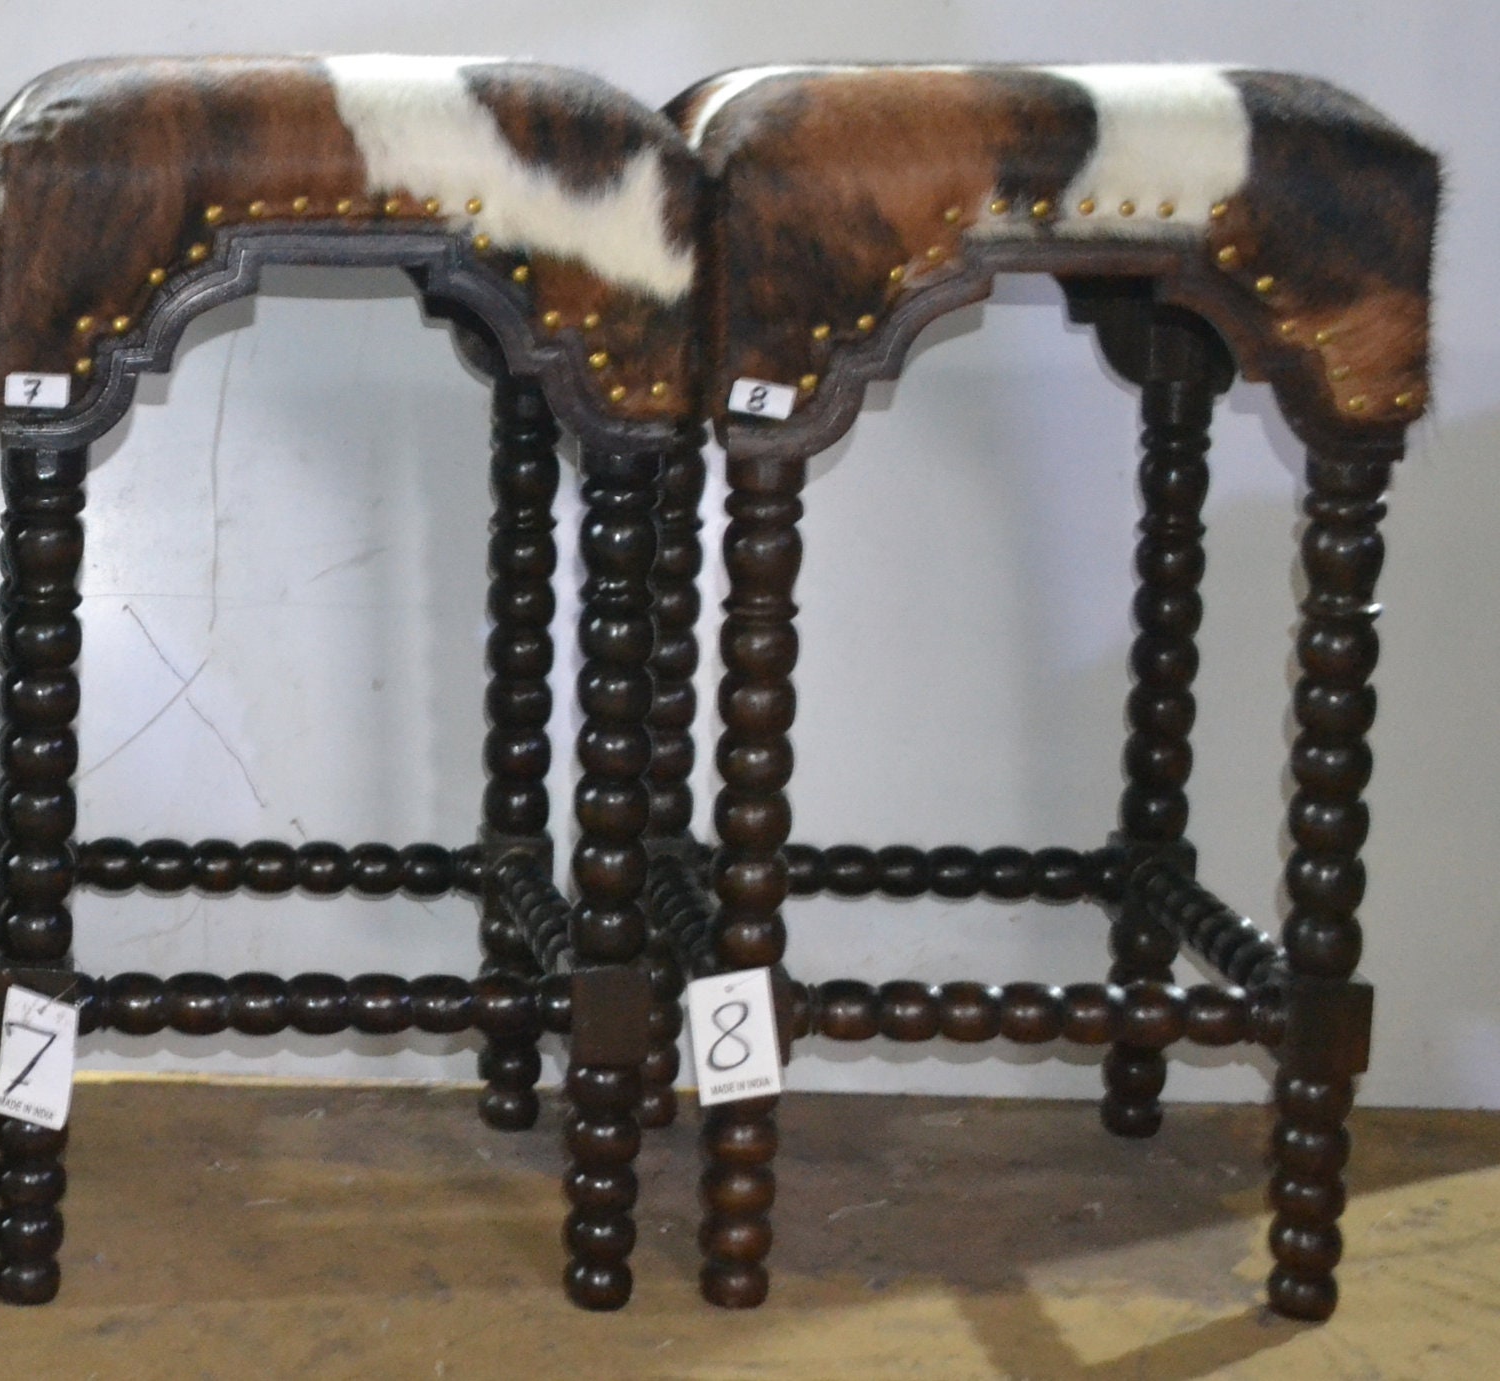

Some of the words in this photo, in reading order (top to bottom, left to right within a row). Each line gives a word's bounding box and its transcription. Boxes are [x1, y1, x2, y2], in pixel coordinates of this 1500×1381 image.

[23, 379, 42, 405] 7
[746, 386, 768, 412] 8
[706, 1000, 750, 1072] 8
[4, 1021, 58, 1096] 7
[710, 1081, 734, 1096] MADE
[736, 1080, 746, 1091] IN
[747, 1077, 770, 1089] INDIA
[23, 1104, 32, 1114] IN
[33, 1106, 54, 1122] INDIA
